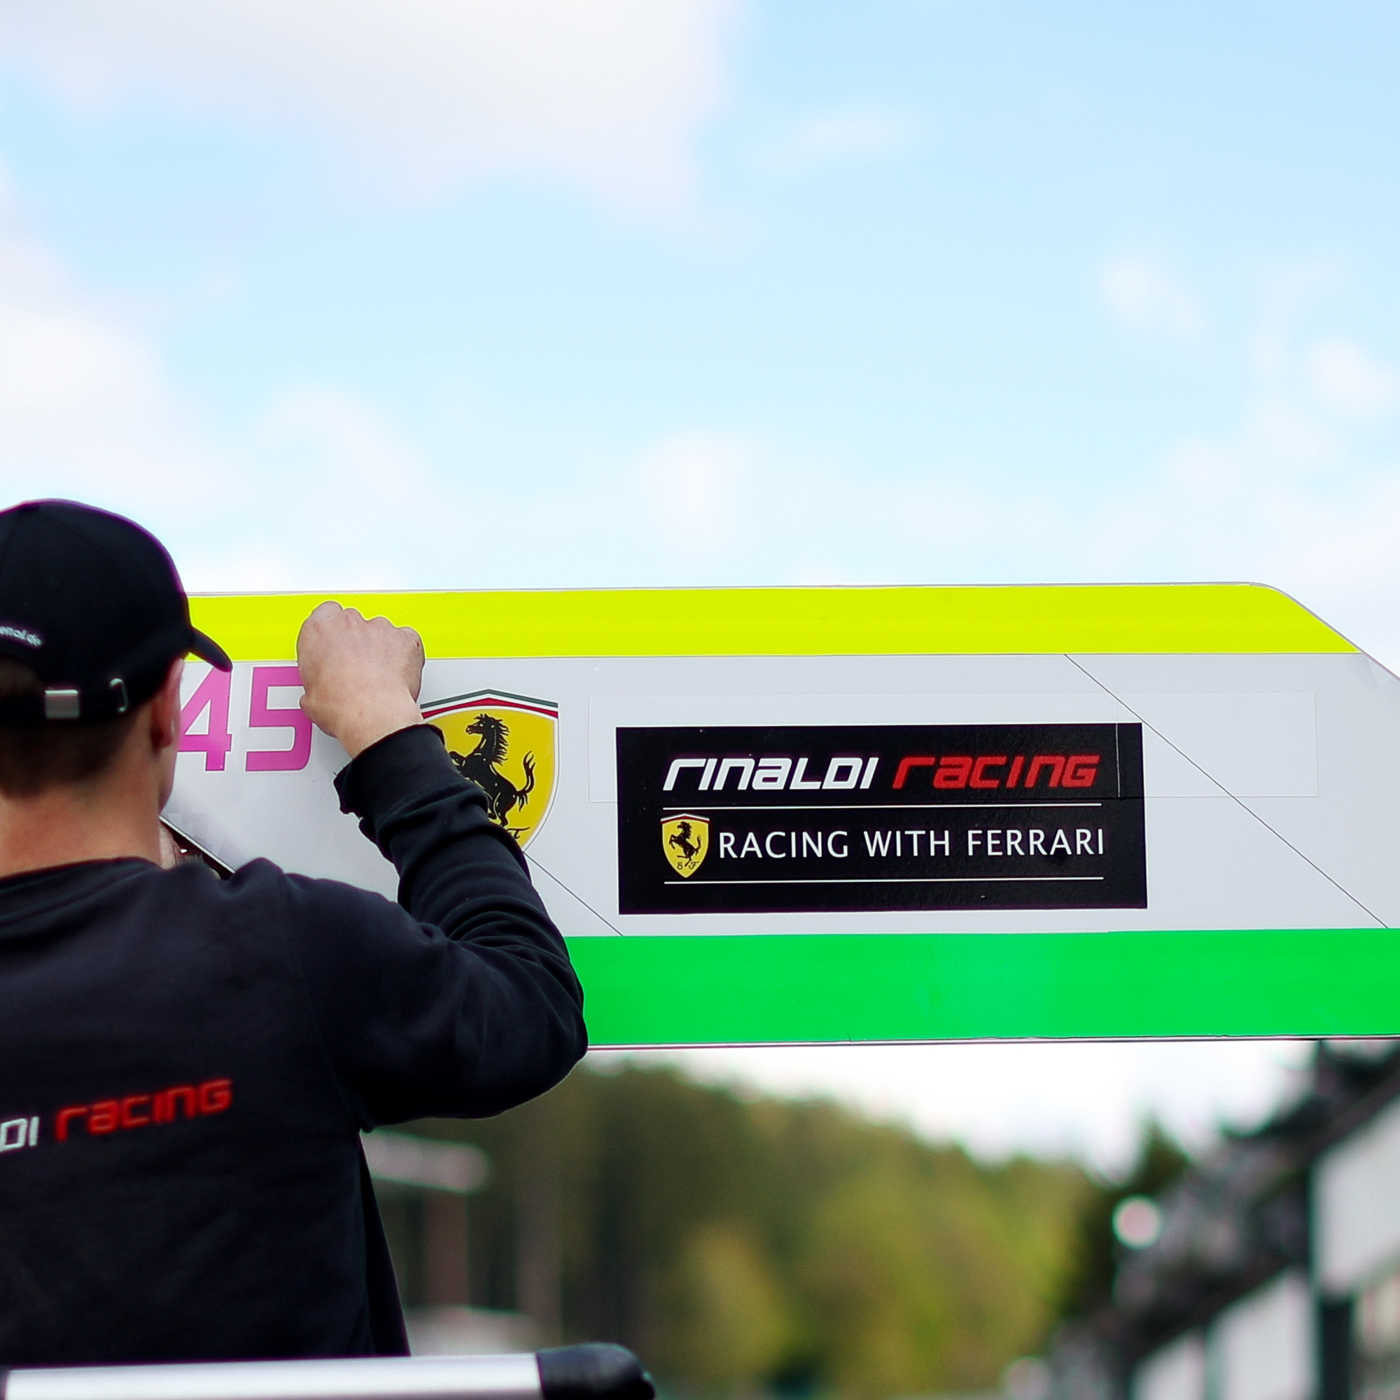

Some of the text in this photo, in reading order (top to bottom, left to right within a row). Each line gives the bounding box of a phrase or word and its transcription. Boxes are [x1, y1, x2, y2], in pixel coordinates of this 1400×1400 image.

[177, 666, 312, 772] 45
[719, 829, 1104, 859] RACING WITH FERRARI
